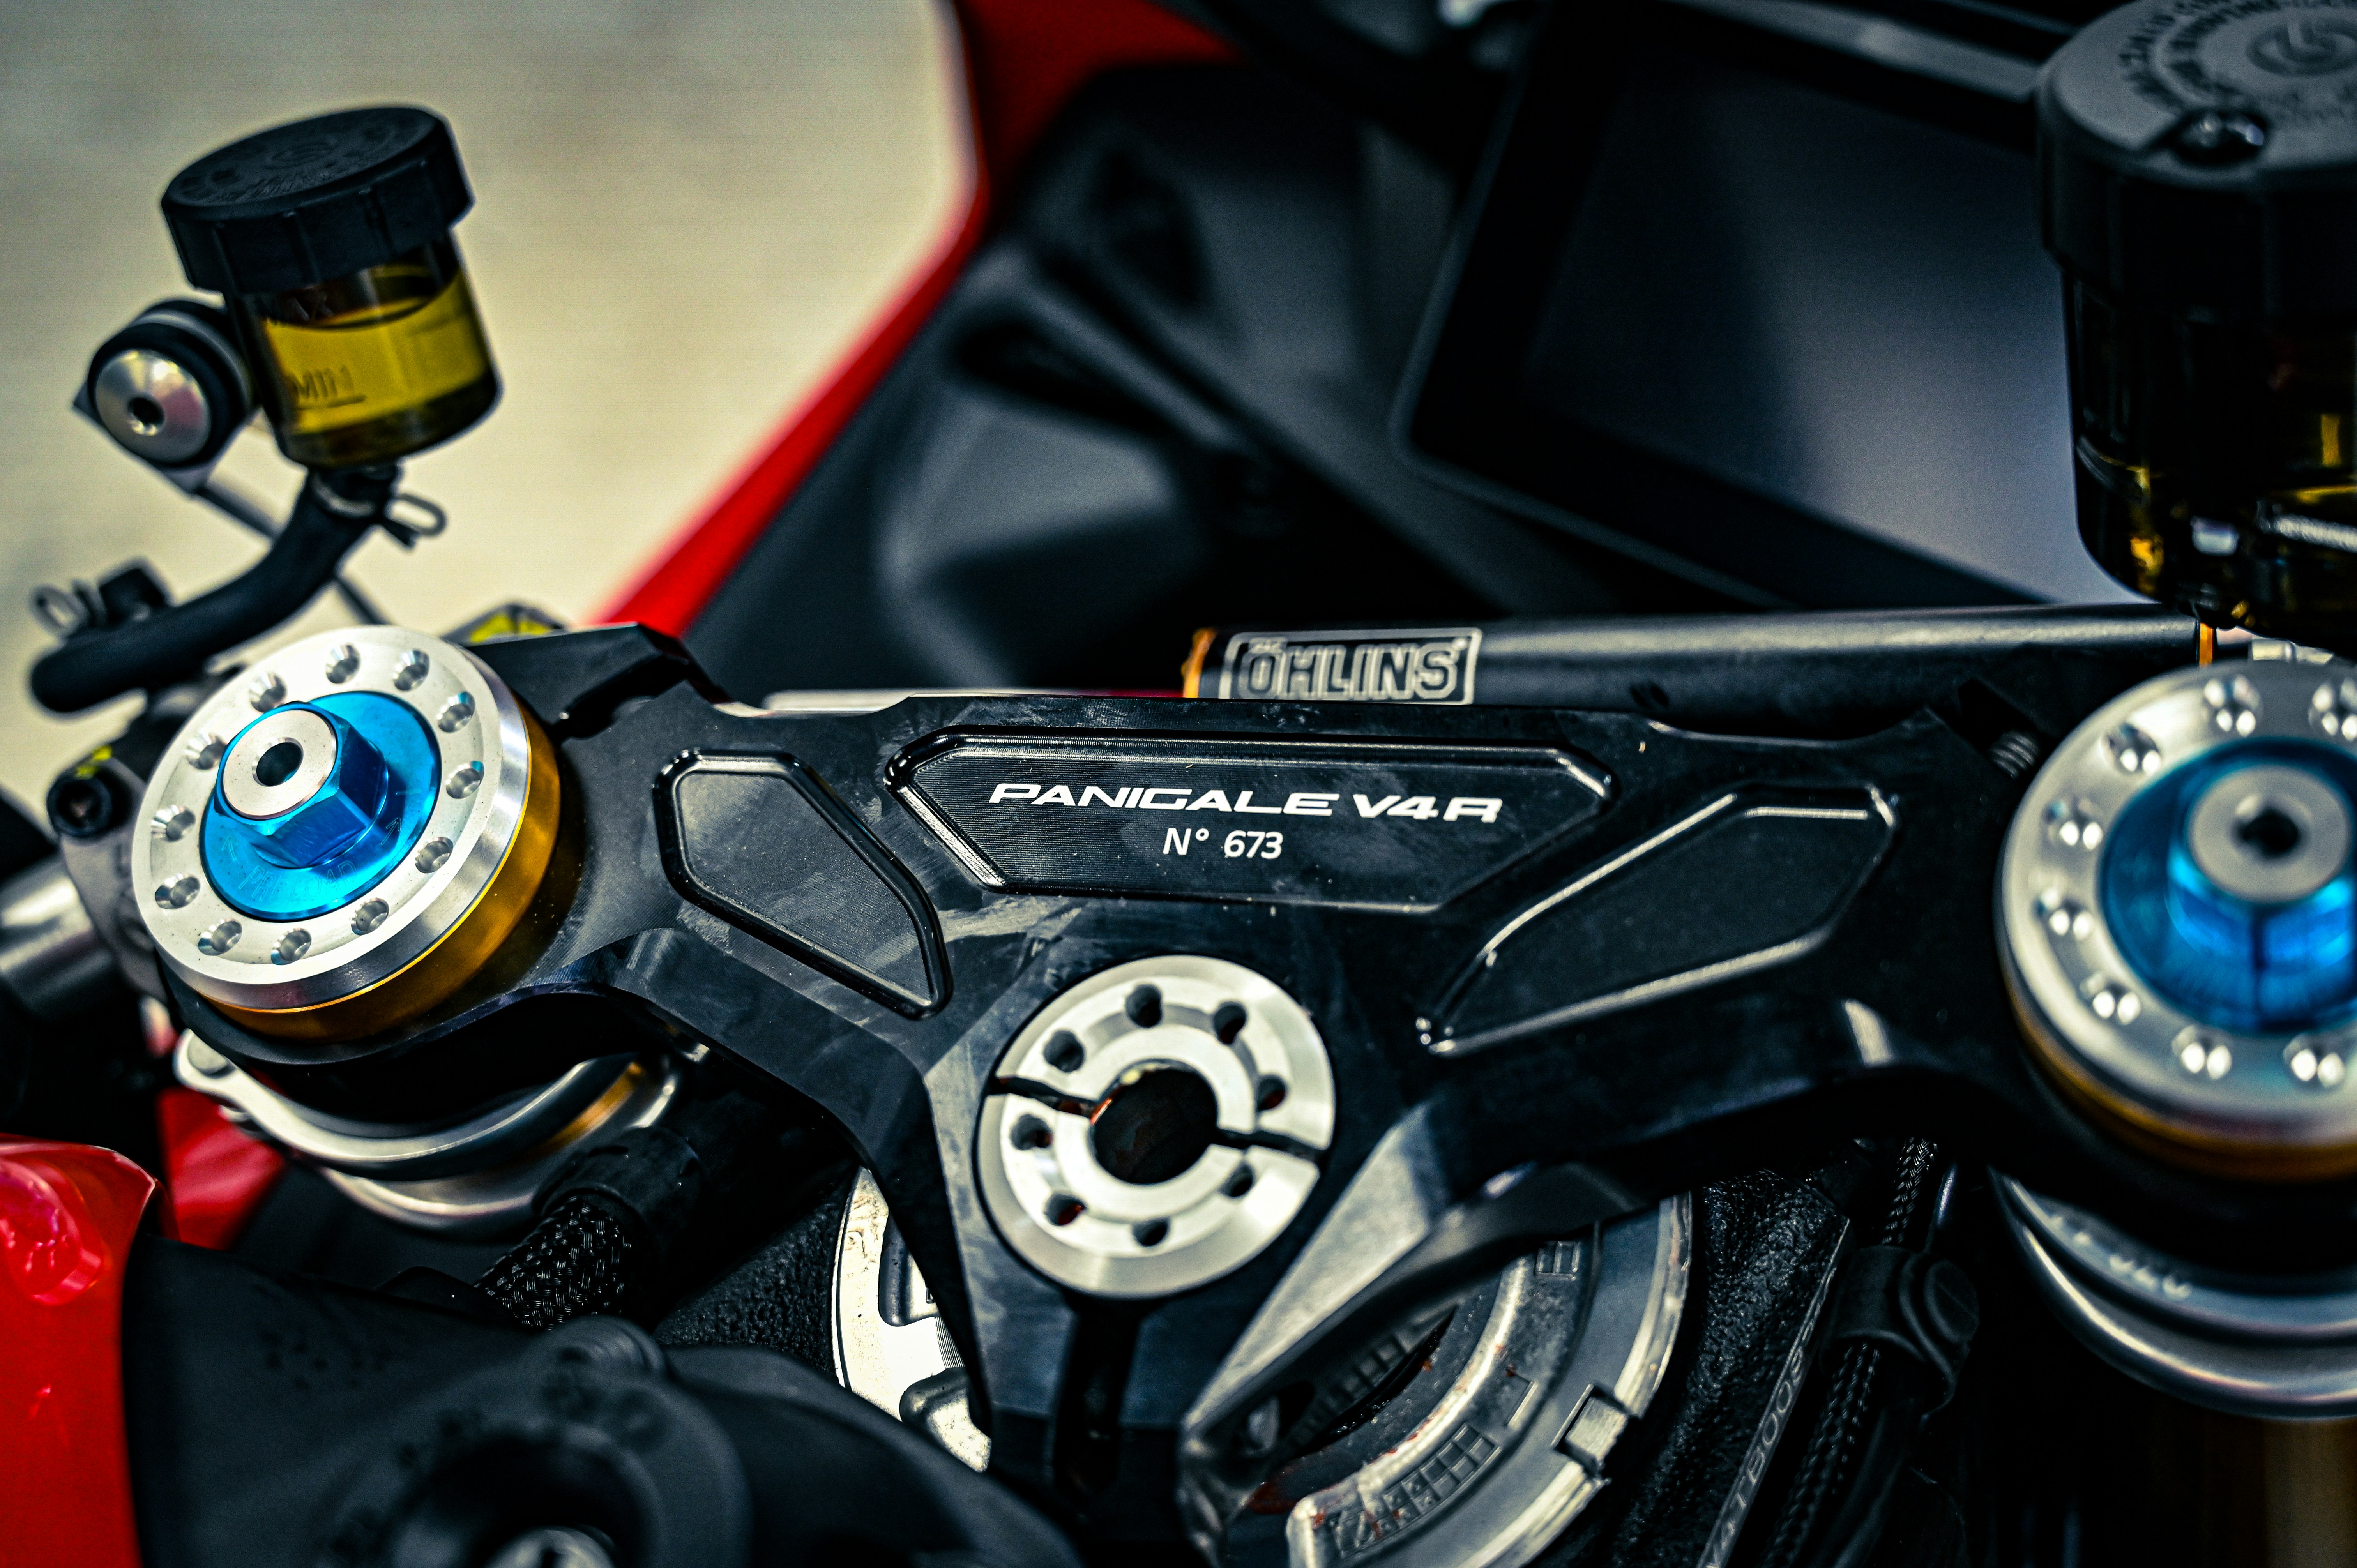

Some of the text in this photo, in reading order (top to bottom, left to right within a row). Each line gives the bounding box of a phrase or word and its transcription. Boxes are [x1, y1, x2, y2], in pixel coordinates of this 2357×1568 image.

[988, 782, 1341, 817] PANIGALE
[1162, 827, 1284, 860] N° 673
